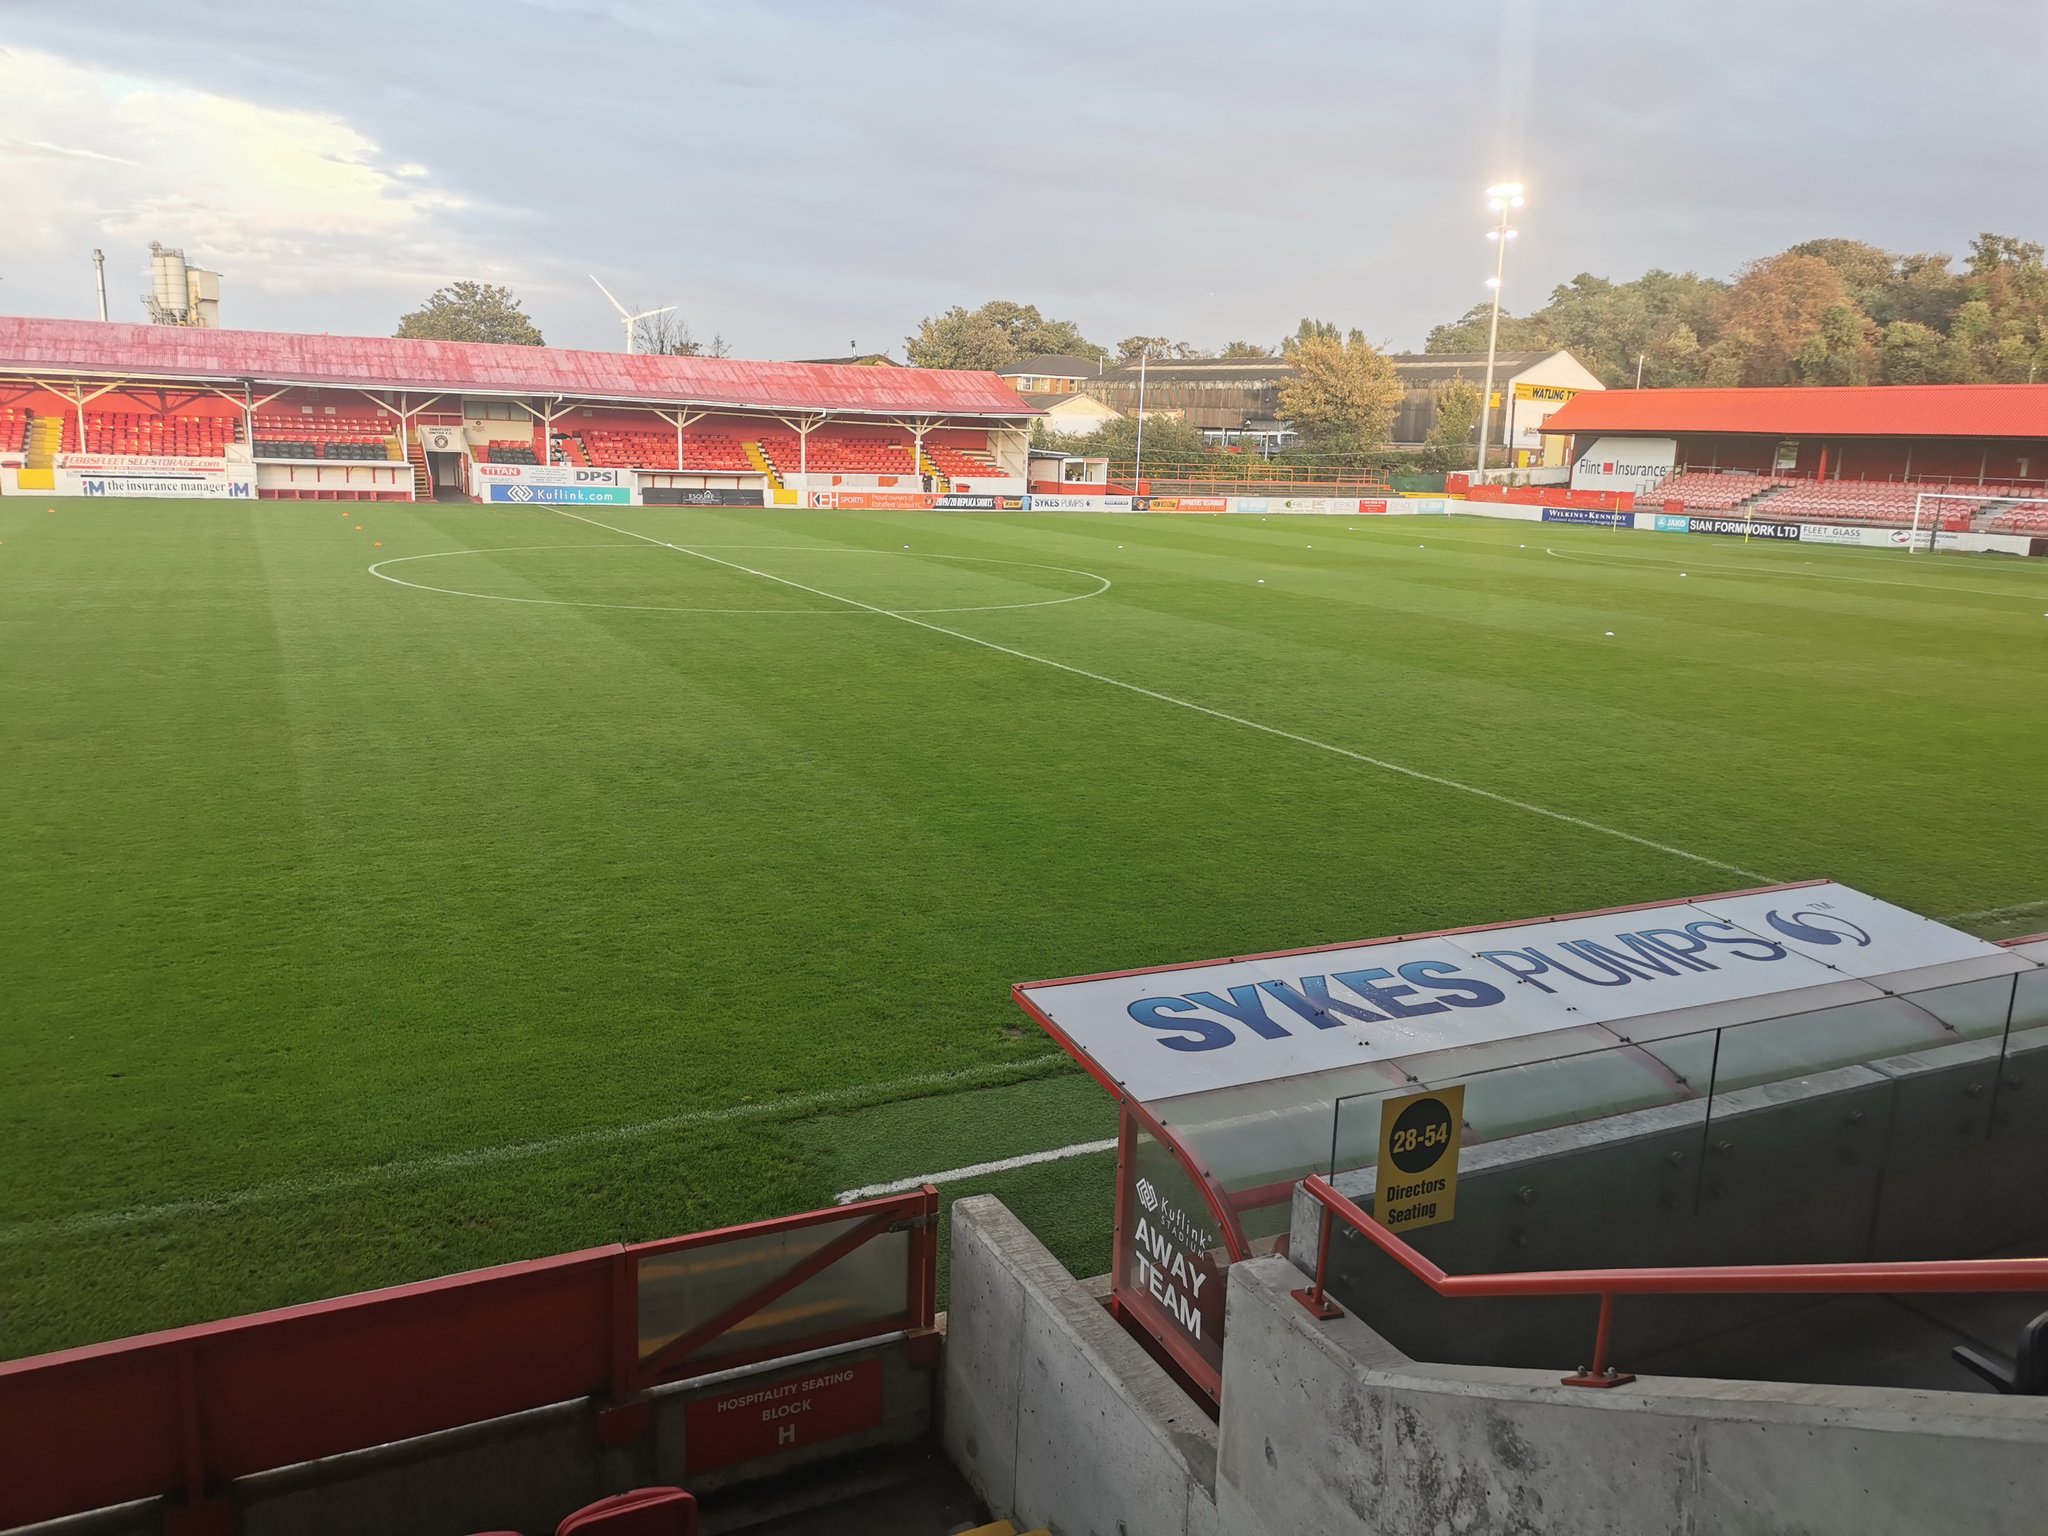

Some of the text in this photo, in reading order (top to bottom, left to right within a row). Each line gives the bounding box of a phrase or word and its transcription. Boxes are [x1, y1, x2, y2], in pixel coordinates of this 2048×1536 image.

[1532, 387, 1564, 400] WATLING
[1567, 390, 1581, 400] TY
[69, 456, 219, 468] EBBSFLEET SELFSTORAGE.com
[1579, 459, 1667, 477] Flint Insurance
[483, 467, 518, 475] TITAN
[576, 471, 612, 482] DPS
[108, 480, 123, 491] the
[126, 480, 178, 492] insurance
[180, 481, 226, 493] manager
[537, 489, 613, 501] Kuflink.com
[840, 496, 864, 504] SPORTS
[936, 497, 957, 507] 2019/20
[957, 498, 977, 507] REPLICA
[977, 498, 993, 507] SHIRTS
[1034, 498, 1085, 508] SYKES PUMPS
[1549, 510, 1628, 521] WILKINS KENNEDY
[1667, 519, 1685, 527] JAKO
[1689, 520, 1798, 538] SIAN FORMWORK LTD
[1803, 526, 1861, 537] FLEET GLASS
[1127, 960, 1506, 1052] SYKES
[1475, 921, 1787, 994] PUMPS
[1393, 1122, 1448, 1154] 28-54
[1387, 1178, 1446, 1203] Directors
[1388, 1203, 1437, 1225] Seating
[1161, 1217, 1205, 1261] STADIUM
[1135, 1217, 1207, 1299] AWAY
[1135, 1250, 1201, 1341] TEAM
[717, 1370, 854, 1413] HOSPITALITY SEATING
[762, 1399, 812, 1421] BLOCK
[778, 1424, 796, 1445] H
